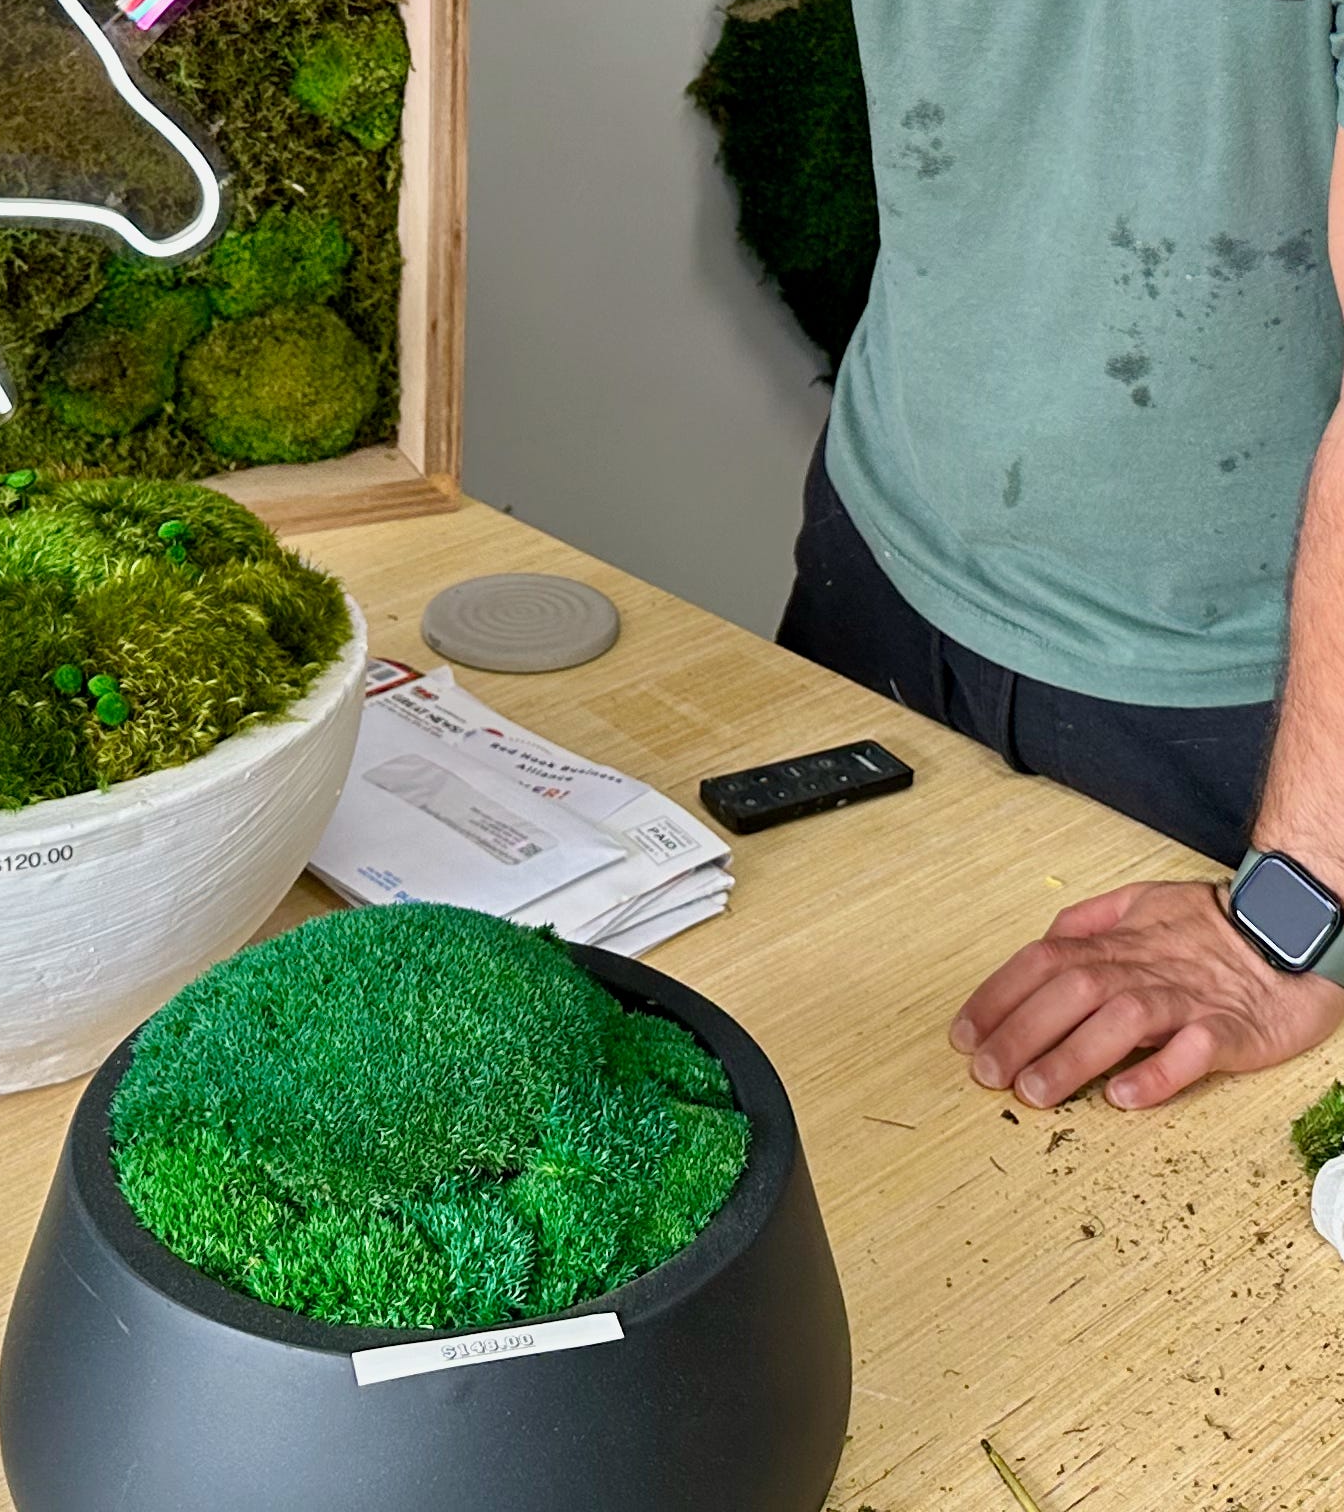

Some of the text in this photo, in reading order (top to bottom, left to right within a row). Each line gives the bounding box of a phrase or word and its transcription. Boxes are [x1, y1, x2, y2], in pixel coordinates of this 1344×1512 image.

[488, 741, 518, 757] Red
[521, 751, 555, 769] Hook
[647, 826, 678, 851] PAID
